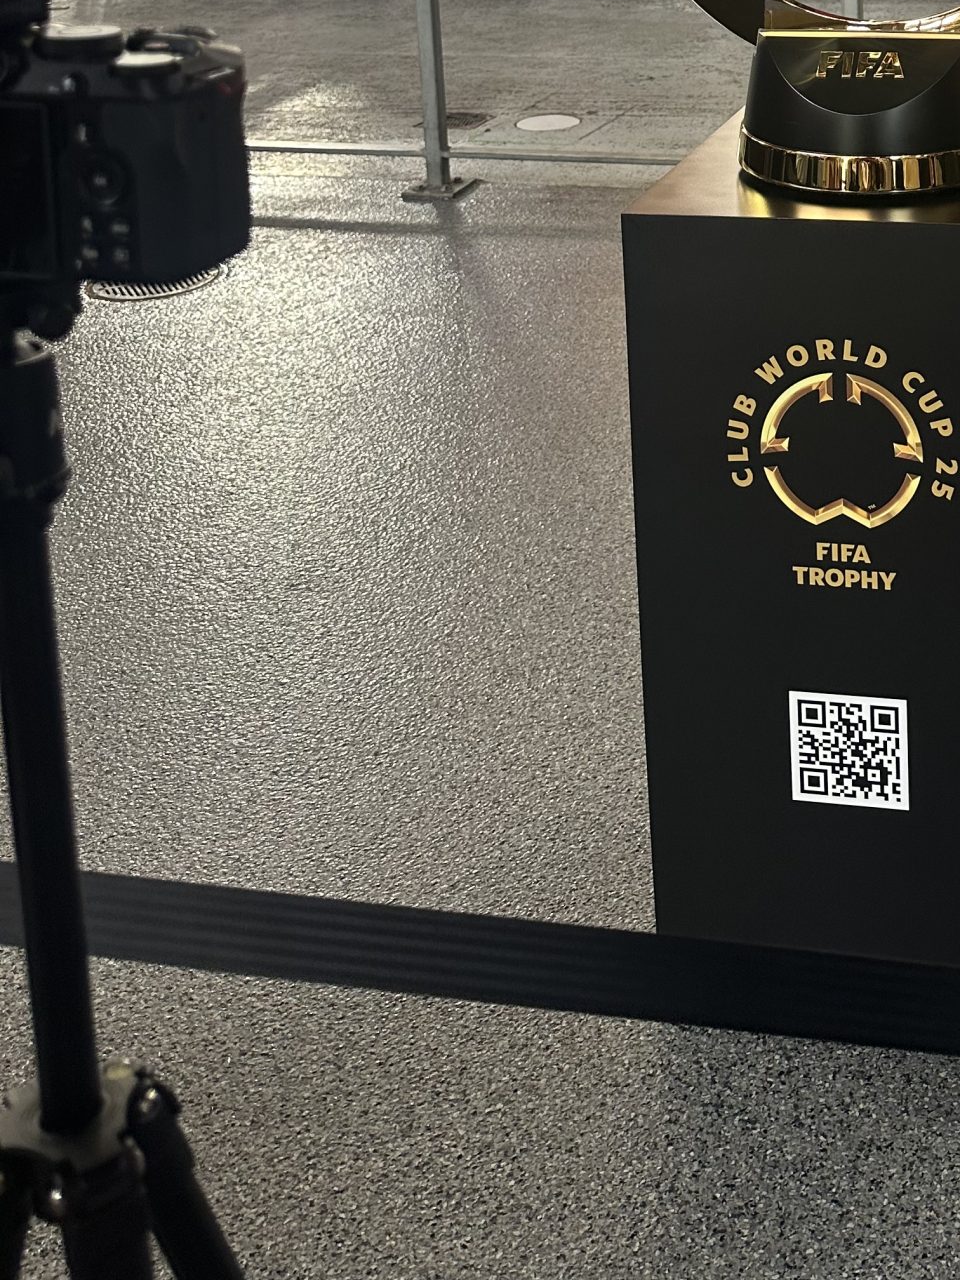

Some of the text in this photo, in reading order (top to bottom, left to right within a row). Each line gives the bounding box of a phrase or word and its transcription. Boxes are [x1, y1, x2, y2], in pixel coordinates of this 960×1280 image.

[816, 50, 904, 79] FIFA
[726, 338, 959, 500] CLUB WORLD CUP 25
[816, 541, 871, 564] FIFA
[792, 565, 897, 591] TROPHY
